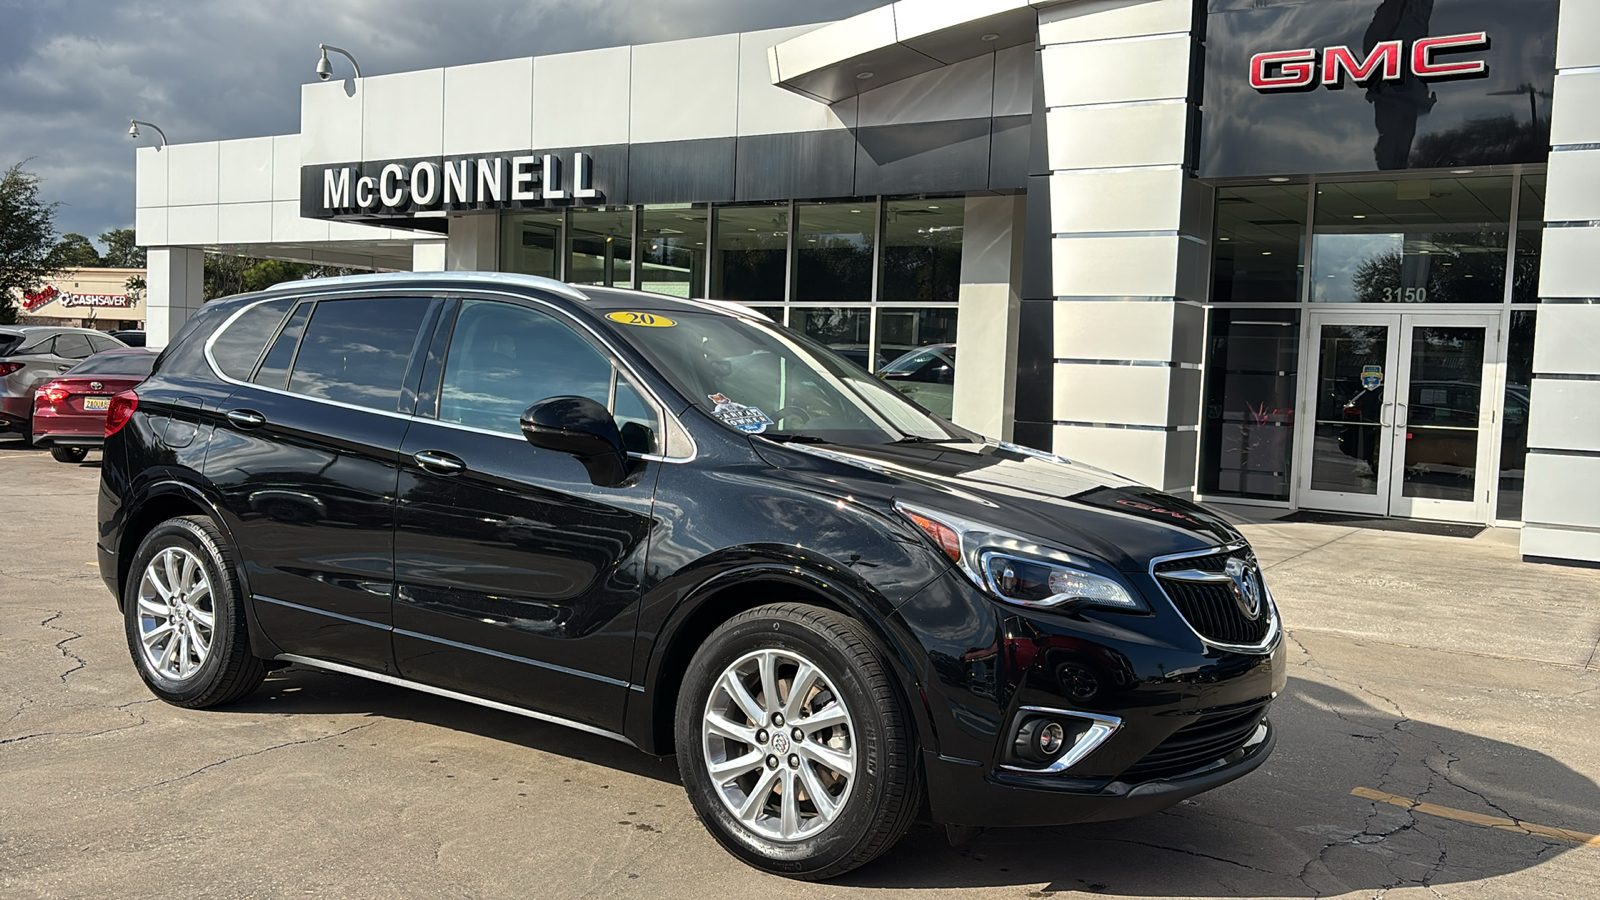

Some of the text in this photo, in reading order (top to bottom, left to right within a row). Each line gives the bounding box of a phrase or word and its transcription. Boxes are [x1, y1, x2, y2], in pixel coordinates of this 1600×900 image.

[1249, 31, 1487, 89] GMC
[323, 152, 596, 209] McCONNELL
[1382, 287, 1427, 303] 3150
[626, 312, 655, 325] 20
